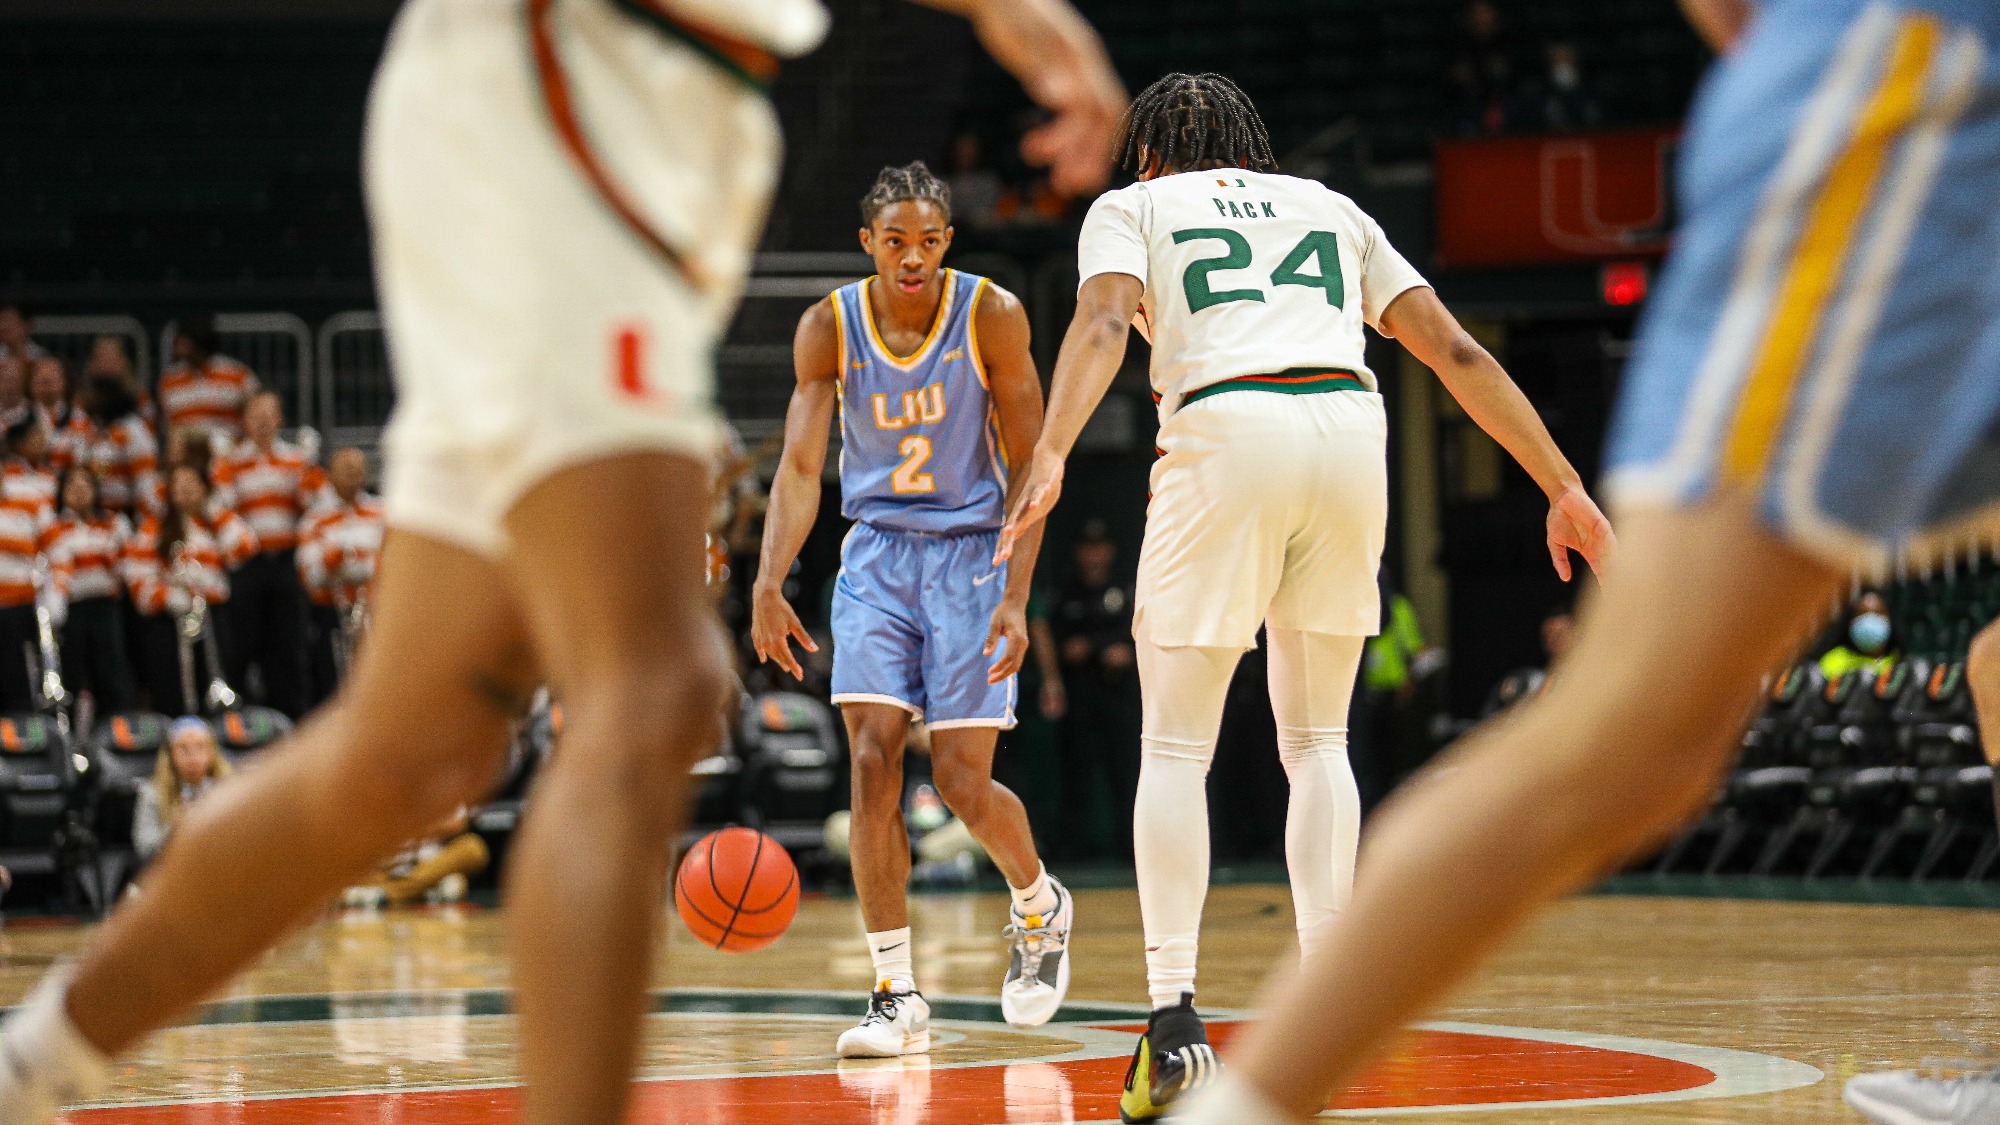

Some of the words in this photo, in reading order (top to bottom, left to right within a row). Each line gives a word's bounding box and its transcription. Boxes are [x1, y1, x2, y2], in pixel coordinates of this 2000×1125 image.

[1212, 197, 1277, 218] PACK
[1172, 227, 1344, 315] 24
[871, 382, 946, 430] LIU
[891, 435, 935, 494] 2
